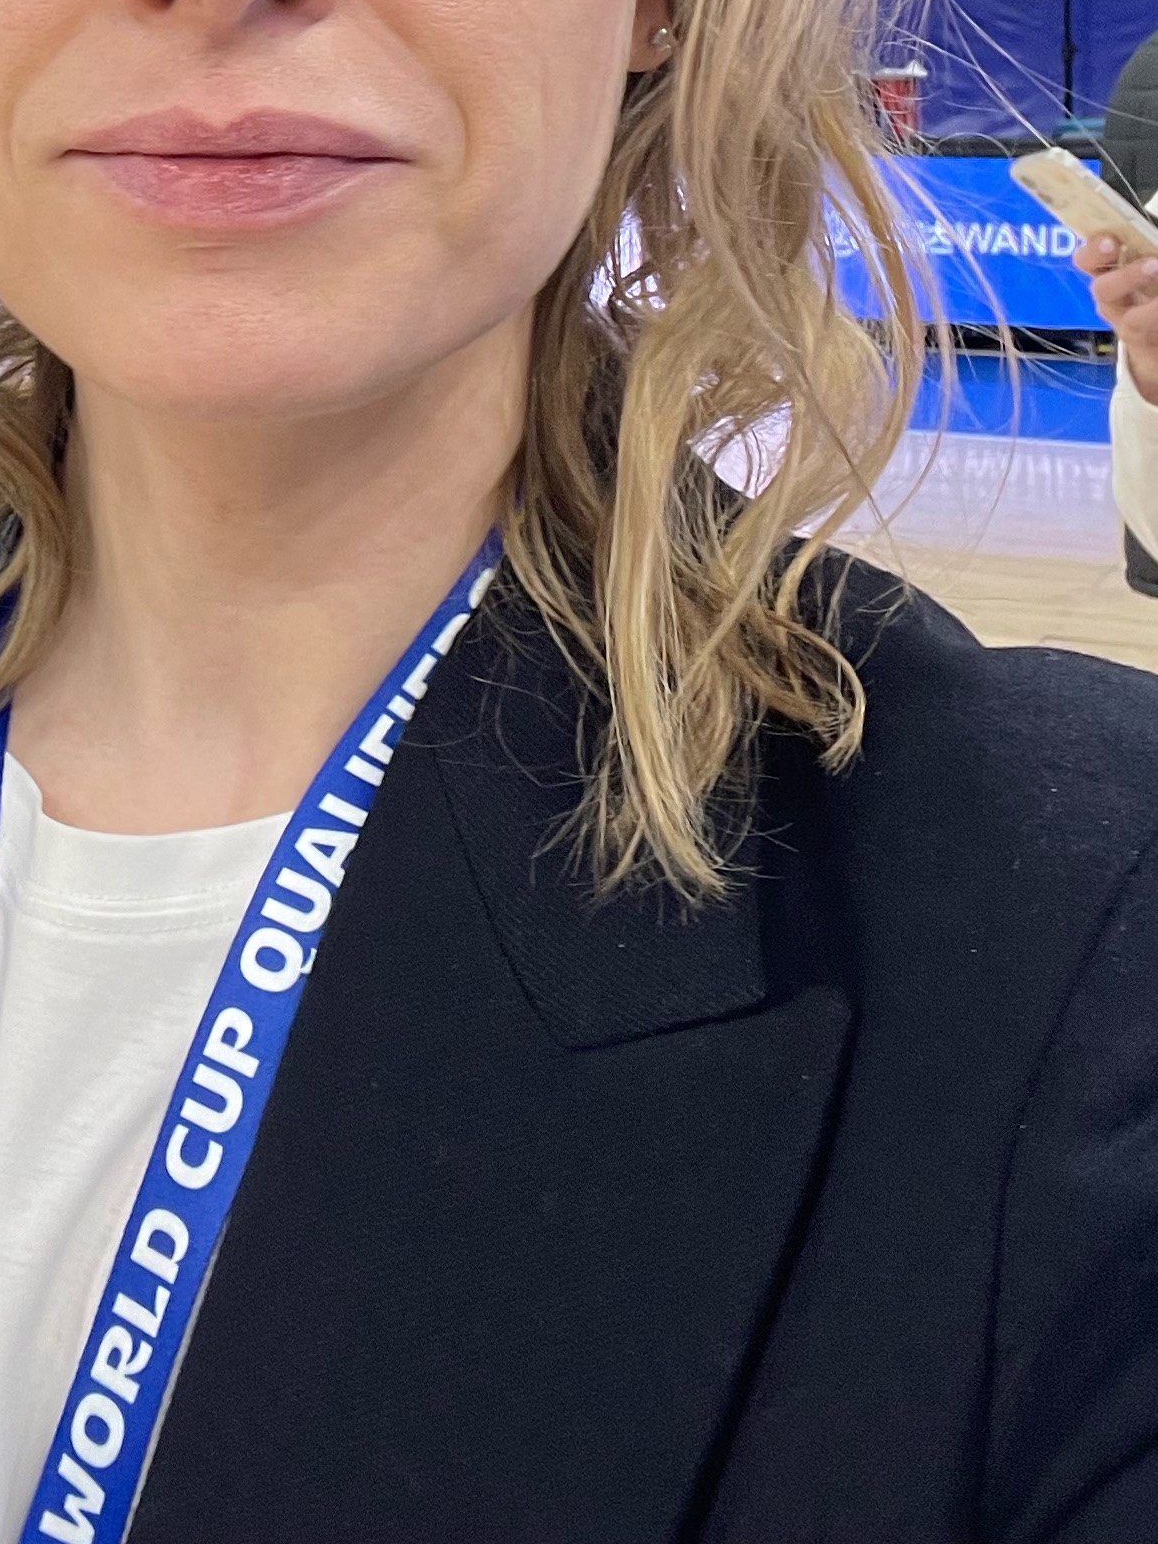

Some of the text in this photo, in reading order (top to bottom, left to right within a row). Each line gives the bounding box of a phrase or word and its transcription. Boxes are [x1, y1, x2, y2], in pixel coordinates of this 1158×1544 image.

[954, 221, 1086, 257] WAND
[39, 1207, 191, 1544] WORLD
[165, 1006, 261, 1190] CUP
